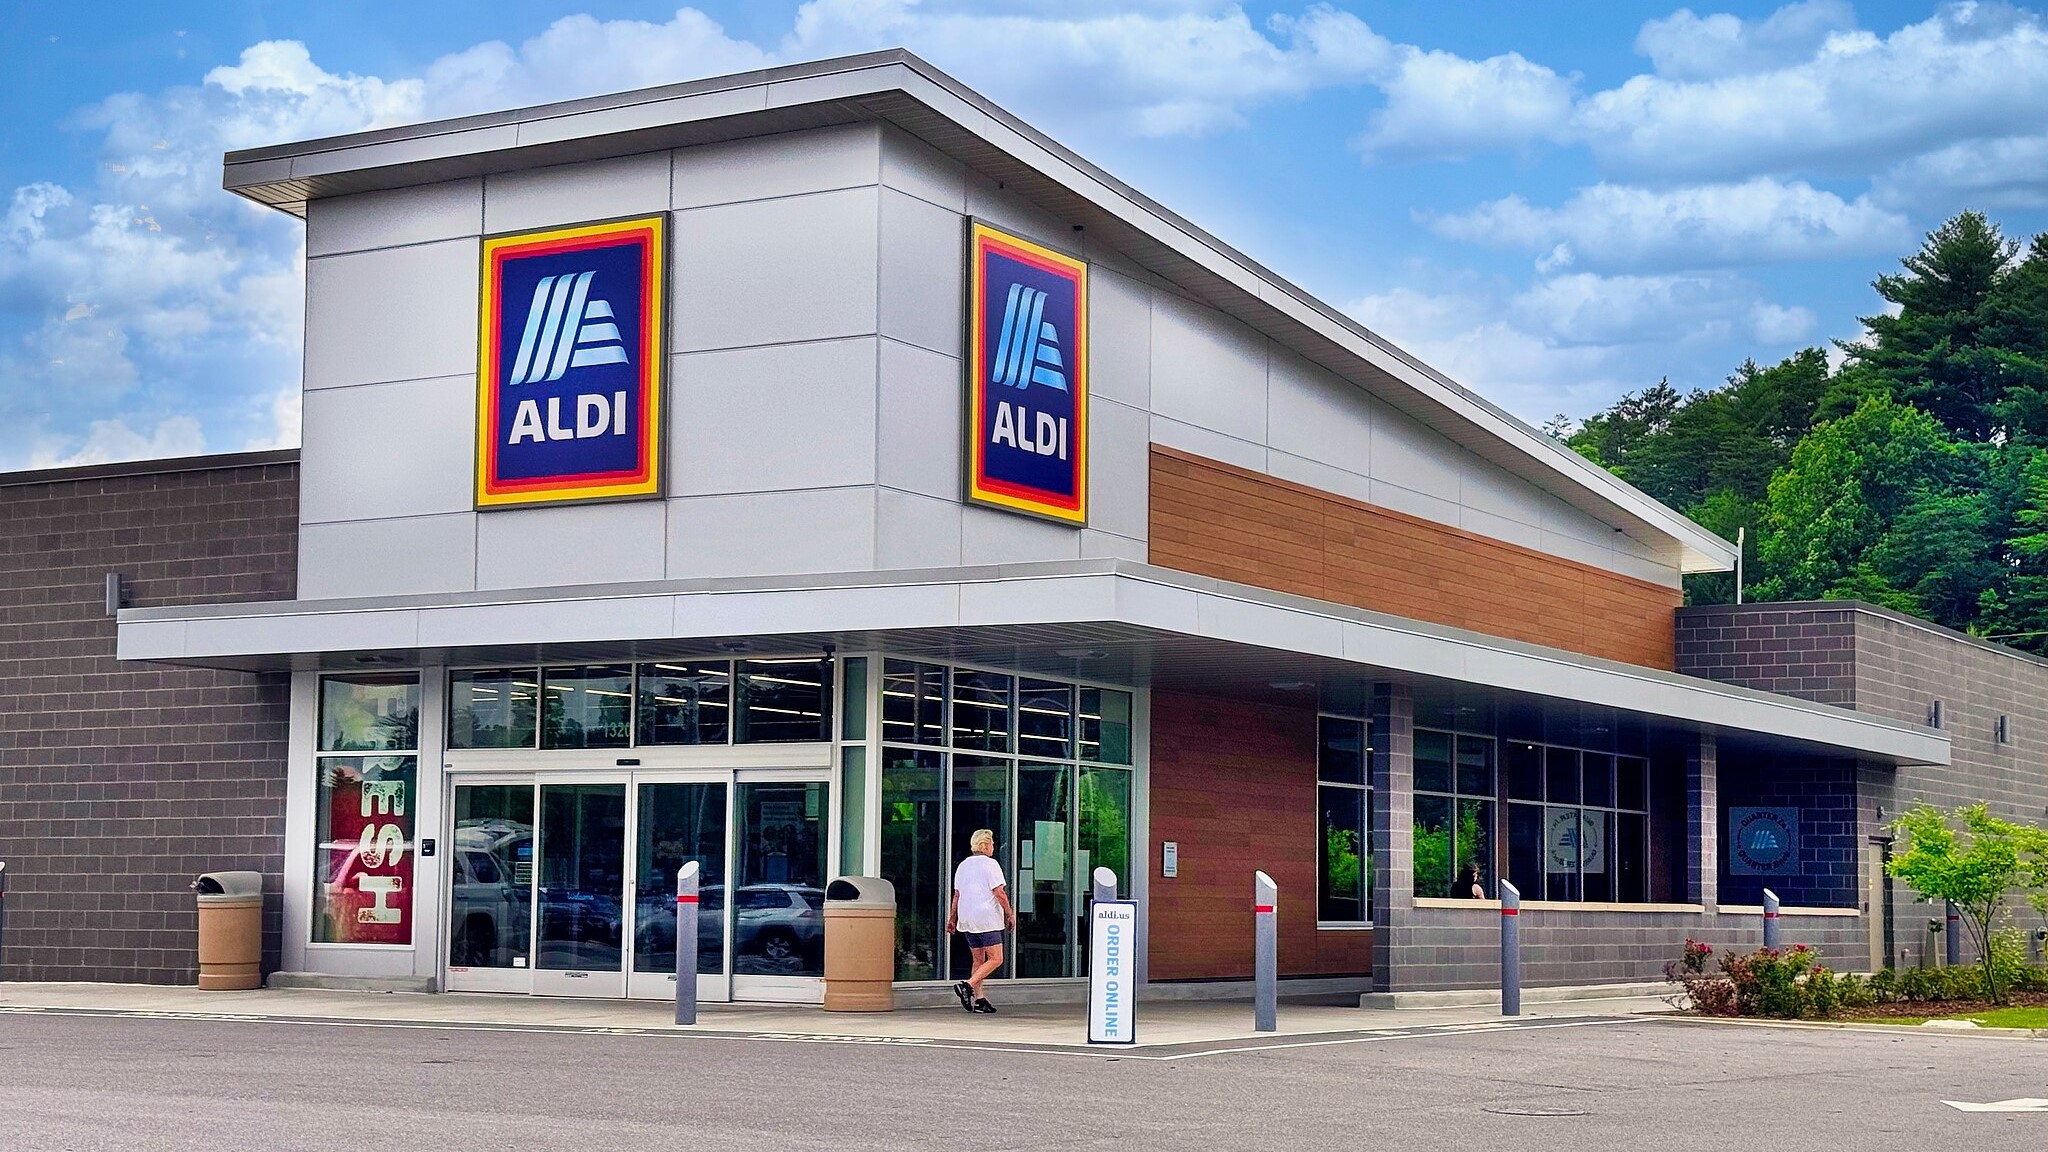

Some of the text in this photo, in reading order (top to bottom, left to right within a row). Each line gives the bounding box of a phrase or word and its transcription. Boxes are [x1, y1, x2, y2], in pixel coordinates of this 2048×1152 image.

[508, 391, 627, 445] ALDI
[991, 401, 1067, 460] ALDI
[358, 685, 407, 924] FRESH
[1098, 910, 1130, 919] aldi.us
[1104, 924, 1120, 1037] ORDER ONLINE
